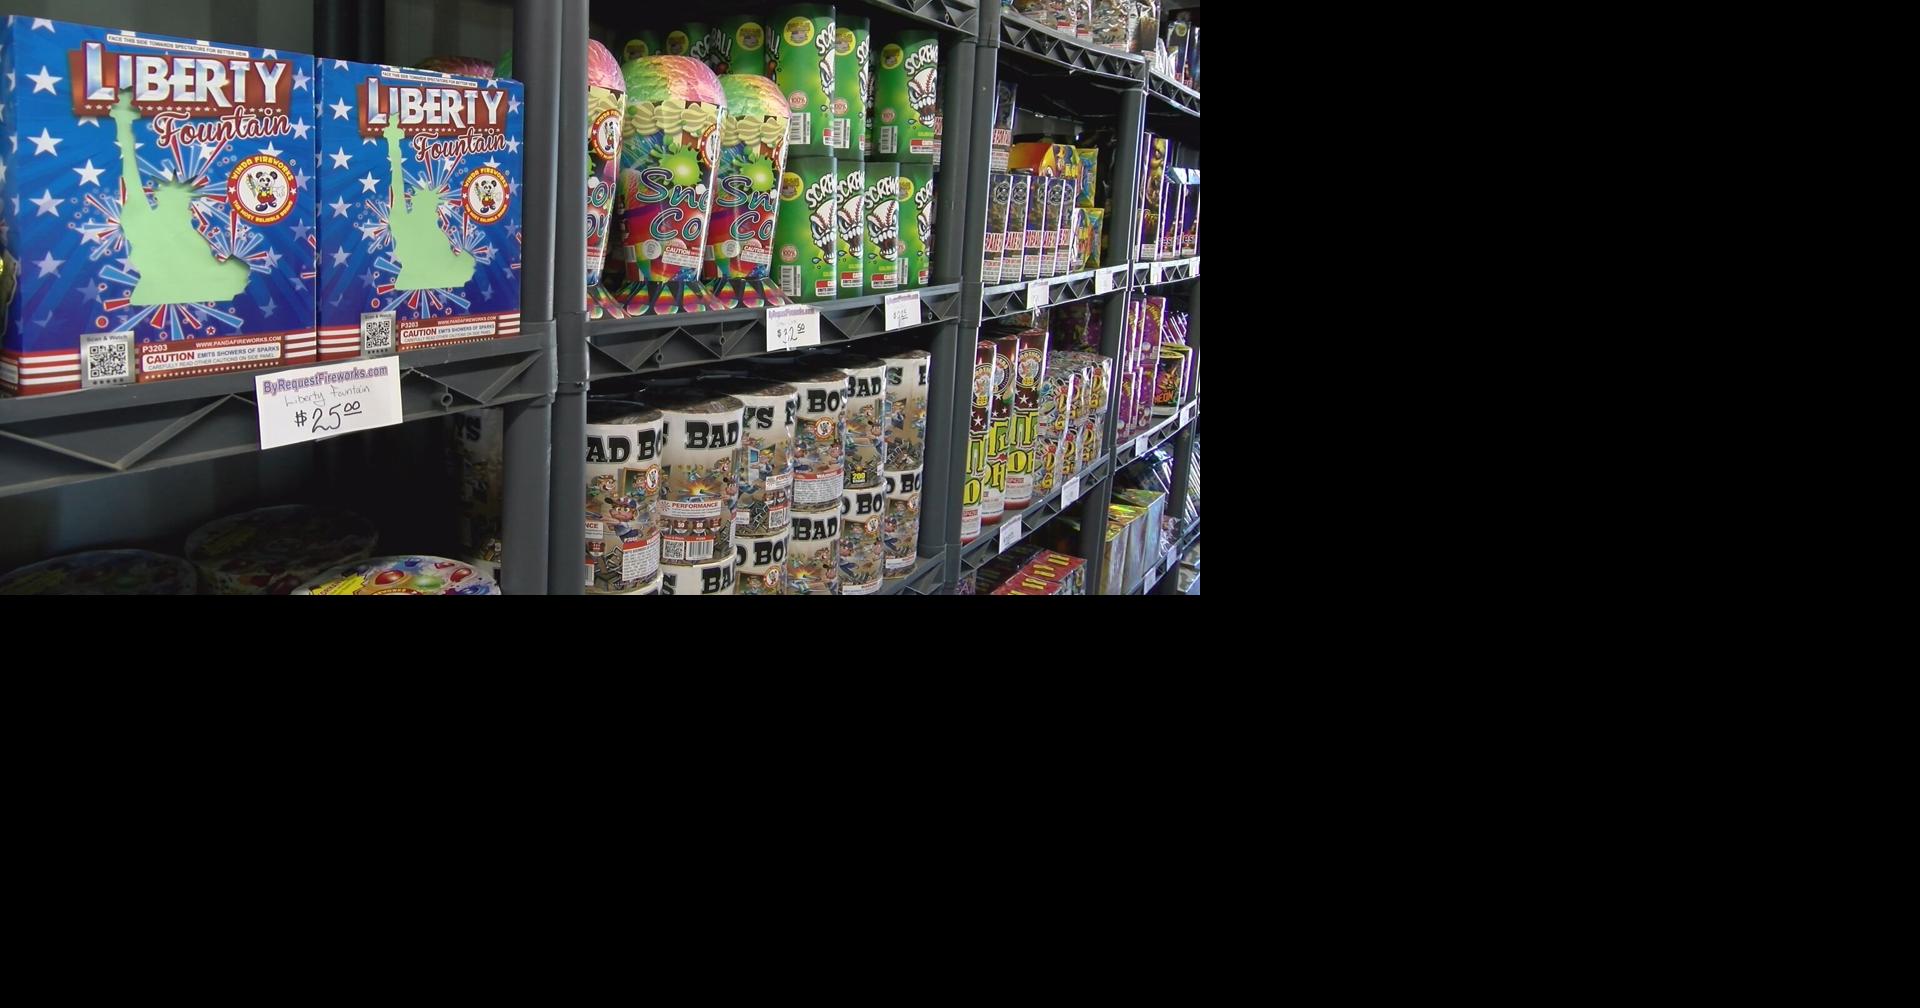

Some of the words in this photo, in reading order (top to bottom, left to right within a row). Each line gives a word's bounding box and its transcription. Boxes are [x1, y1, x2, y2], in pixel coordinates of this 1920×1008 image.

[85, 40, 287, 107] LIBERTY
[368, 78, 504, 128] LIBERTY
[153, 105, 292, 148] Fountain
[413, 126, 506, 162] Fountain
[231, 159, 253, 180] WINDA
[254, 155, 294, 181] FIREWORKS
[195, 335, 282, 348] WWW.PANDAFIREWORKS.COM
[403, 328, 437, 338] CAUTION
[142, 344, 168, 353] P3203
[146, 351, 195, 365] CAUTION
[216, 349, 247, 357] SHOWERS
[262, 365, 389, 397] ByRequestFireworks.com
[685, 419, 740, 450] BAD
[792, 516, 838, 542] BAD
